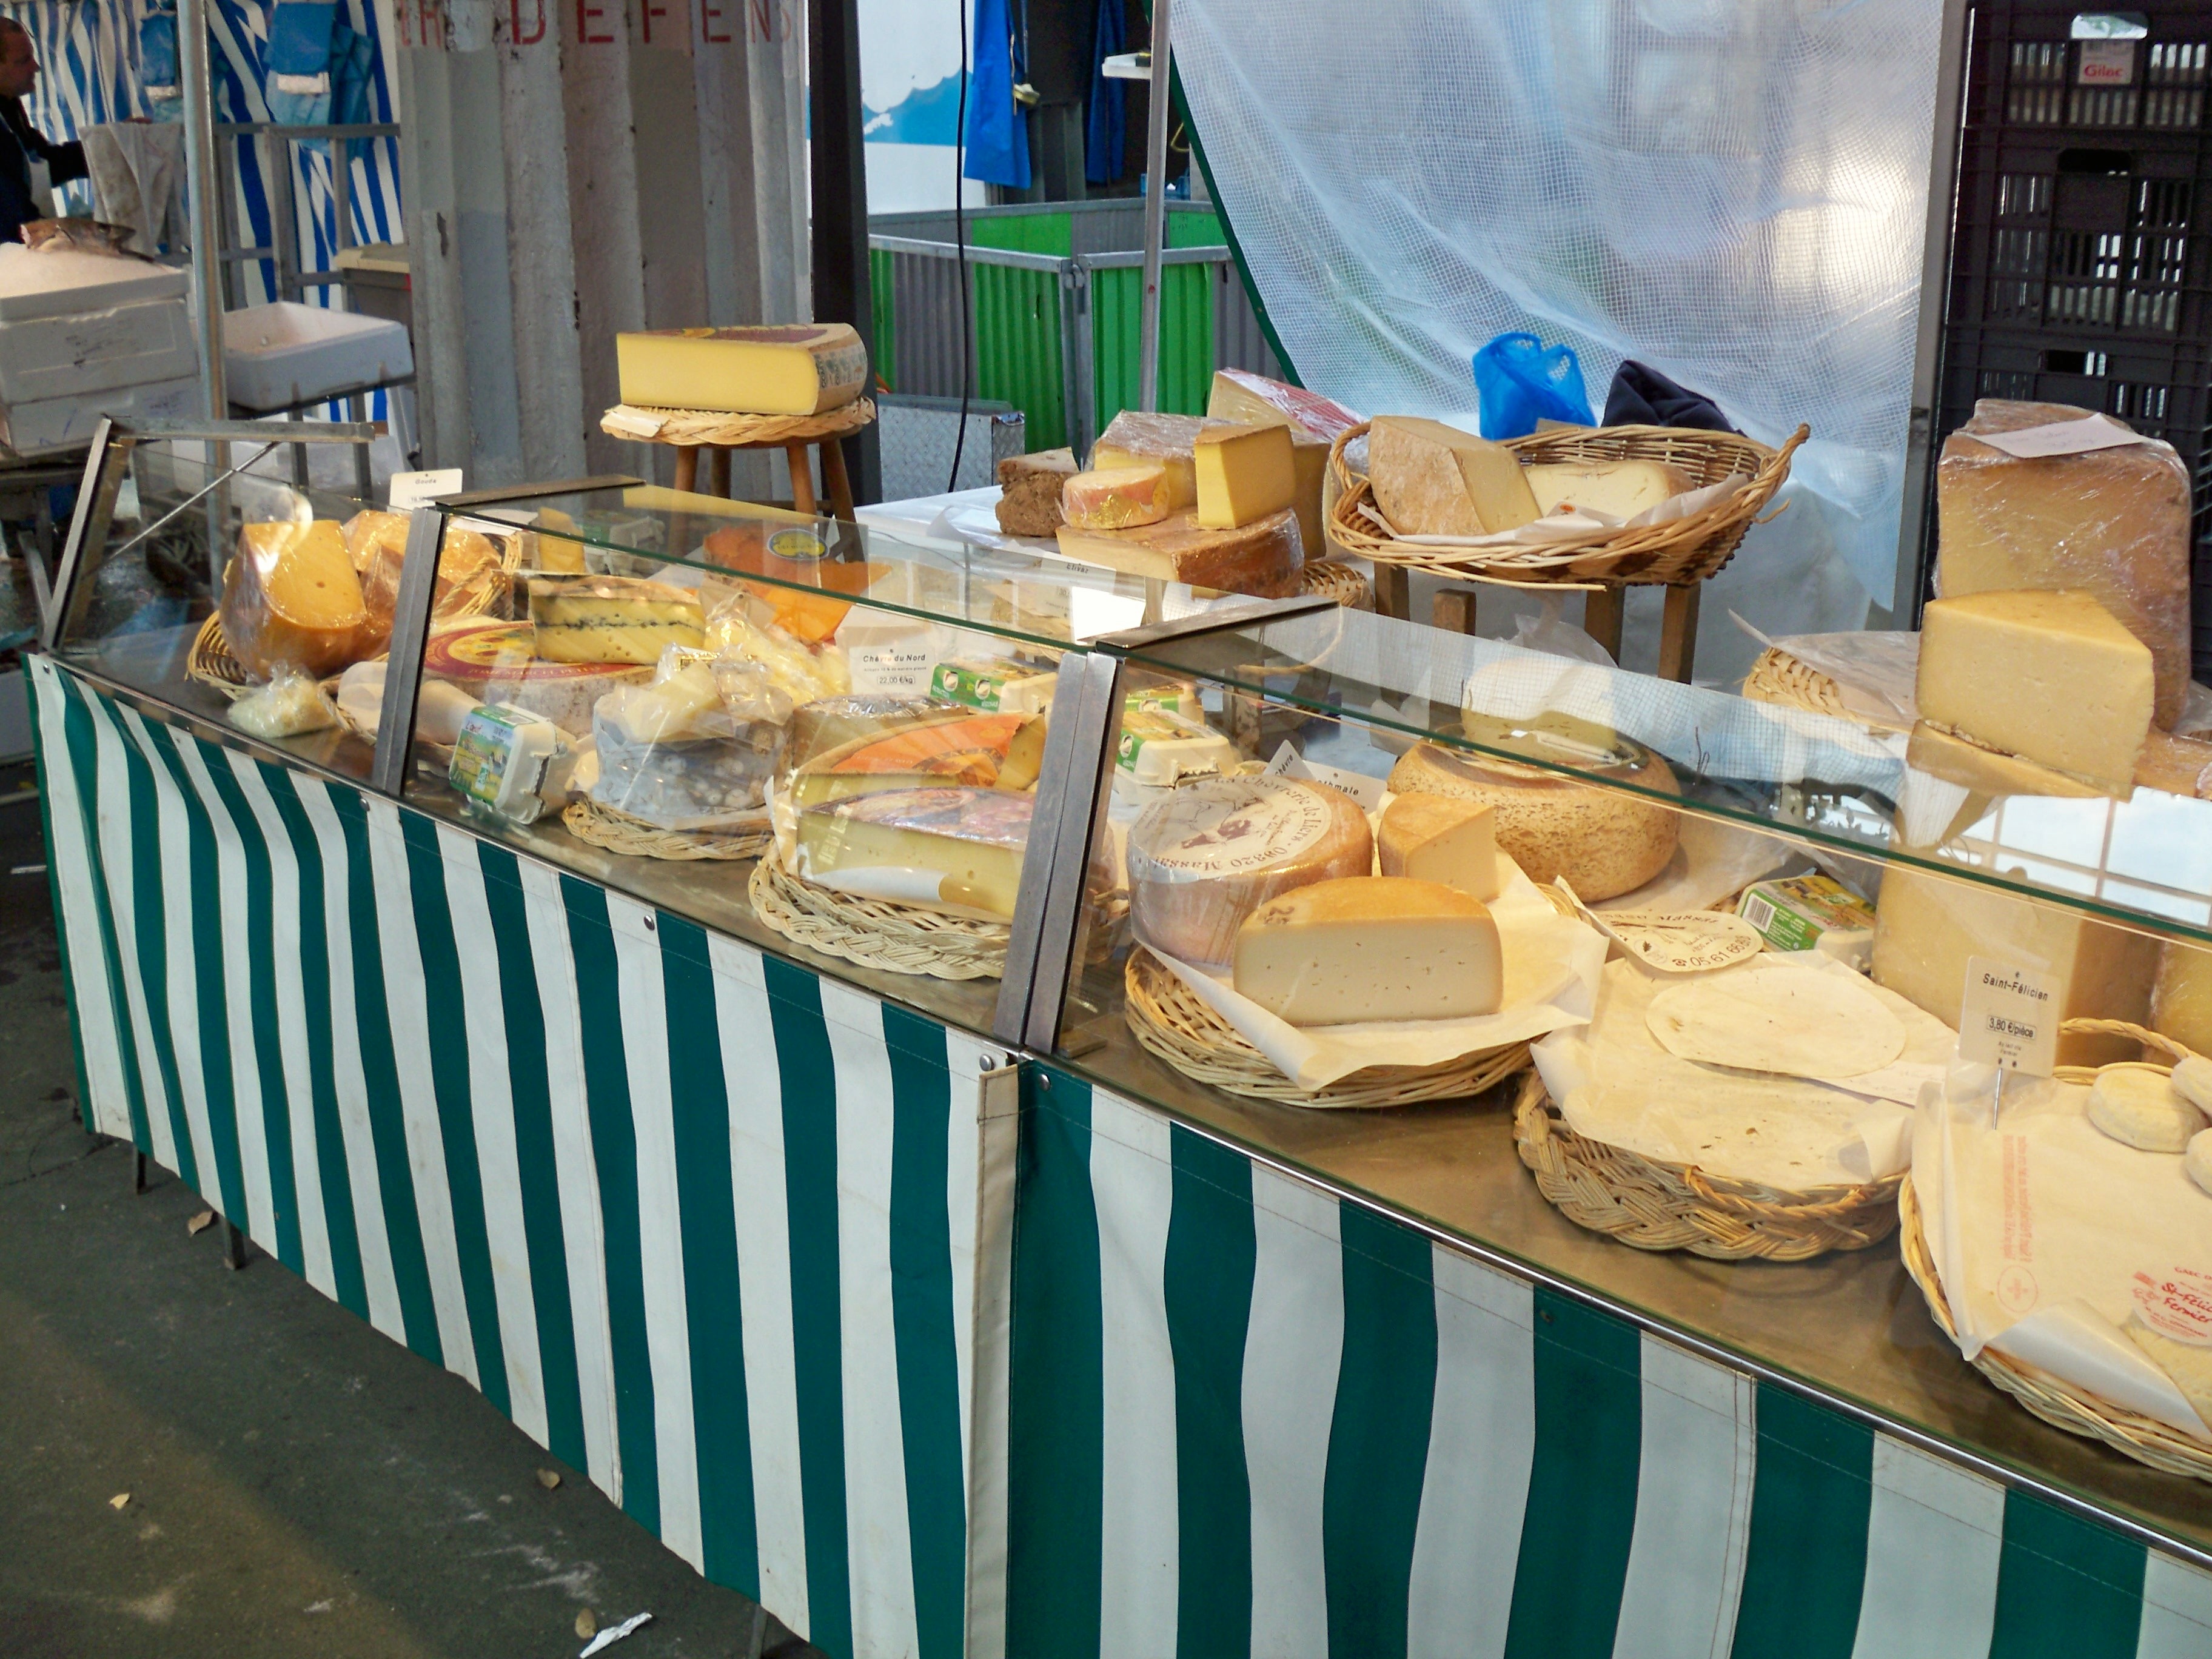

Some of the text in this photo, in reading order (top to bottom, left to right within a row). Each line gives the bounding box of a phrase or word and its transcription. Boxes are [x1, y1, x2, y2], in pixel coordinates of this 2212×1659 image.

[1317, 780, 1359, 796] ethmale
[1303, 807, 1321, 816] de
[1689, 956, 1711, 967] 05
[1711, 950, 1731, 962] 61
[1983, 973, 2048, 1001] Saint-Félicien
[1989, 1017, 2006, 1031] 3,80
